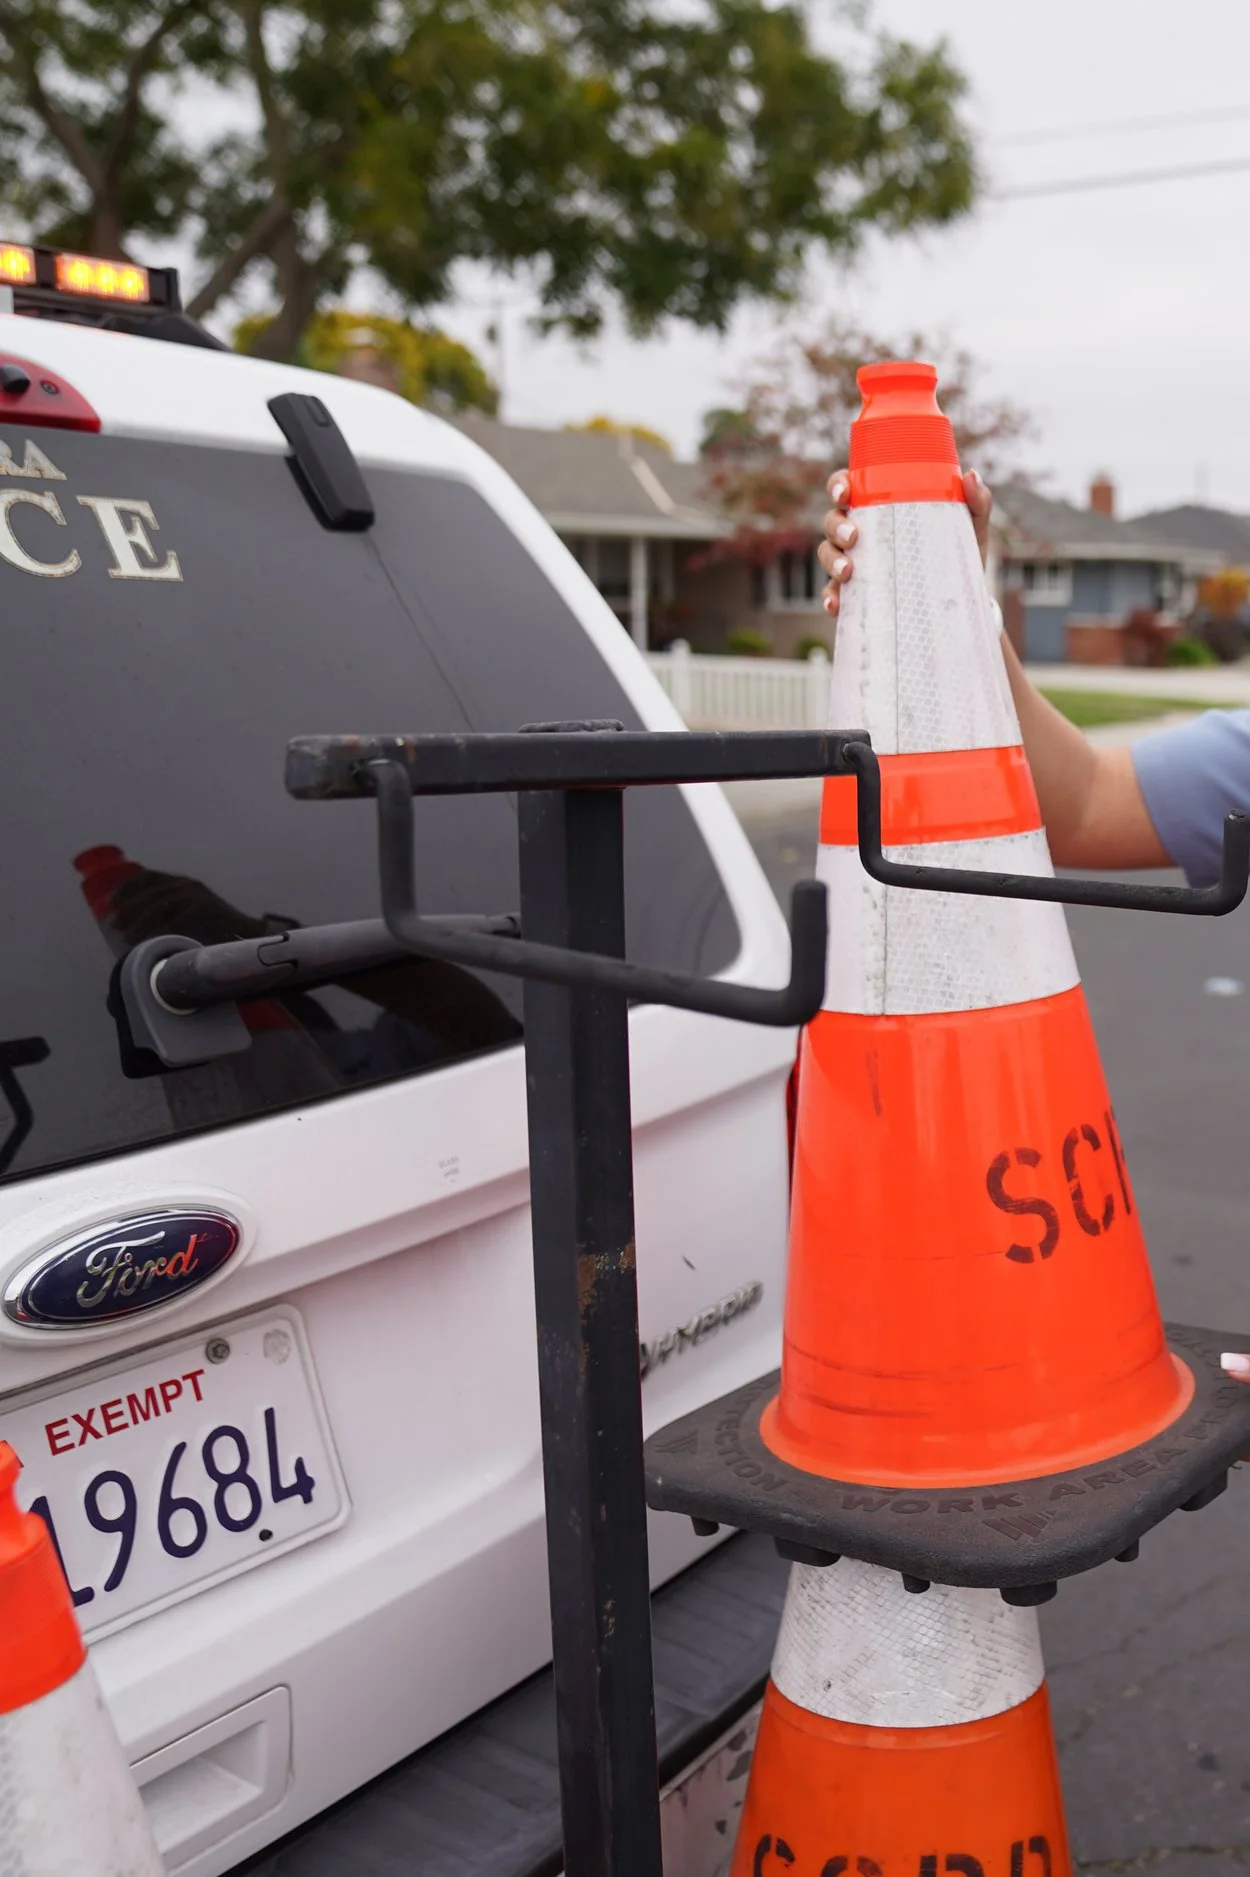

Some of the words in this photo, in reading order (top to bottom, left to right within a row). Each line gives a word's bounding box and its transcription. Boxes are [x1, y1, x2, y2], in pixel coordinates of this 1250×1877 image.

[76, 1230, 200, 1308] Ford
[45, 1368, 206, 1456] EXEMPT
[840, 1491, 1024, 1515] WORK
[1048, 1445, 1189, 1501] AREA
